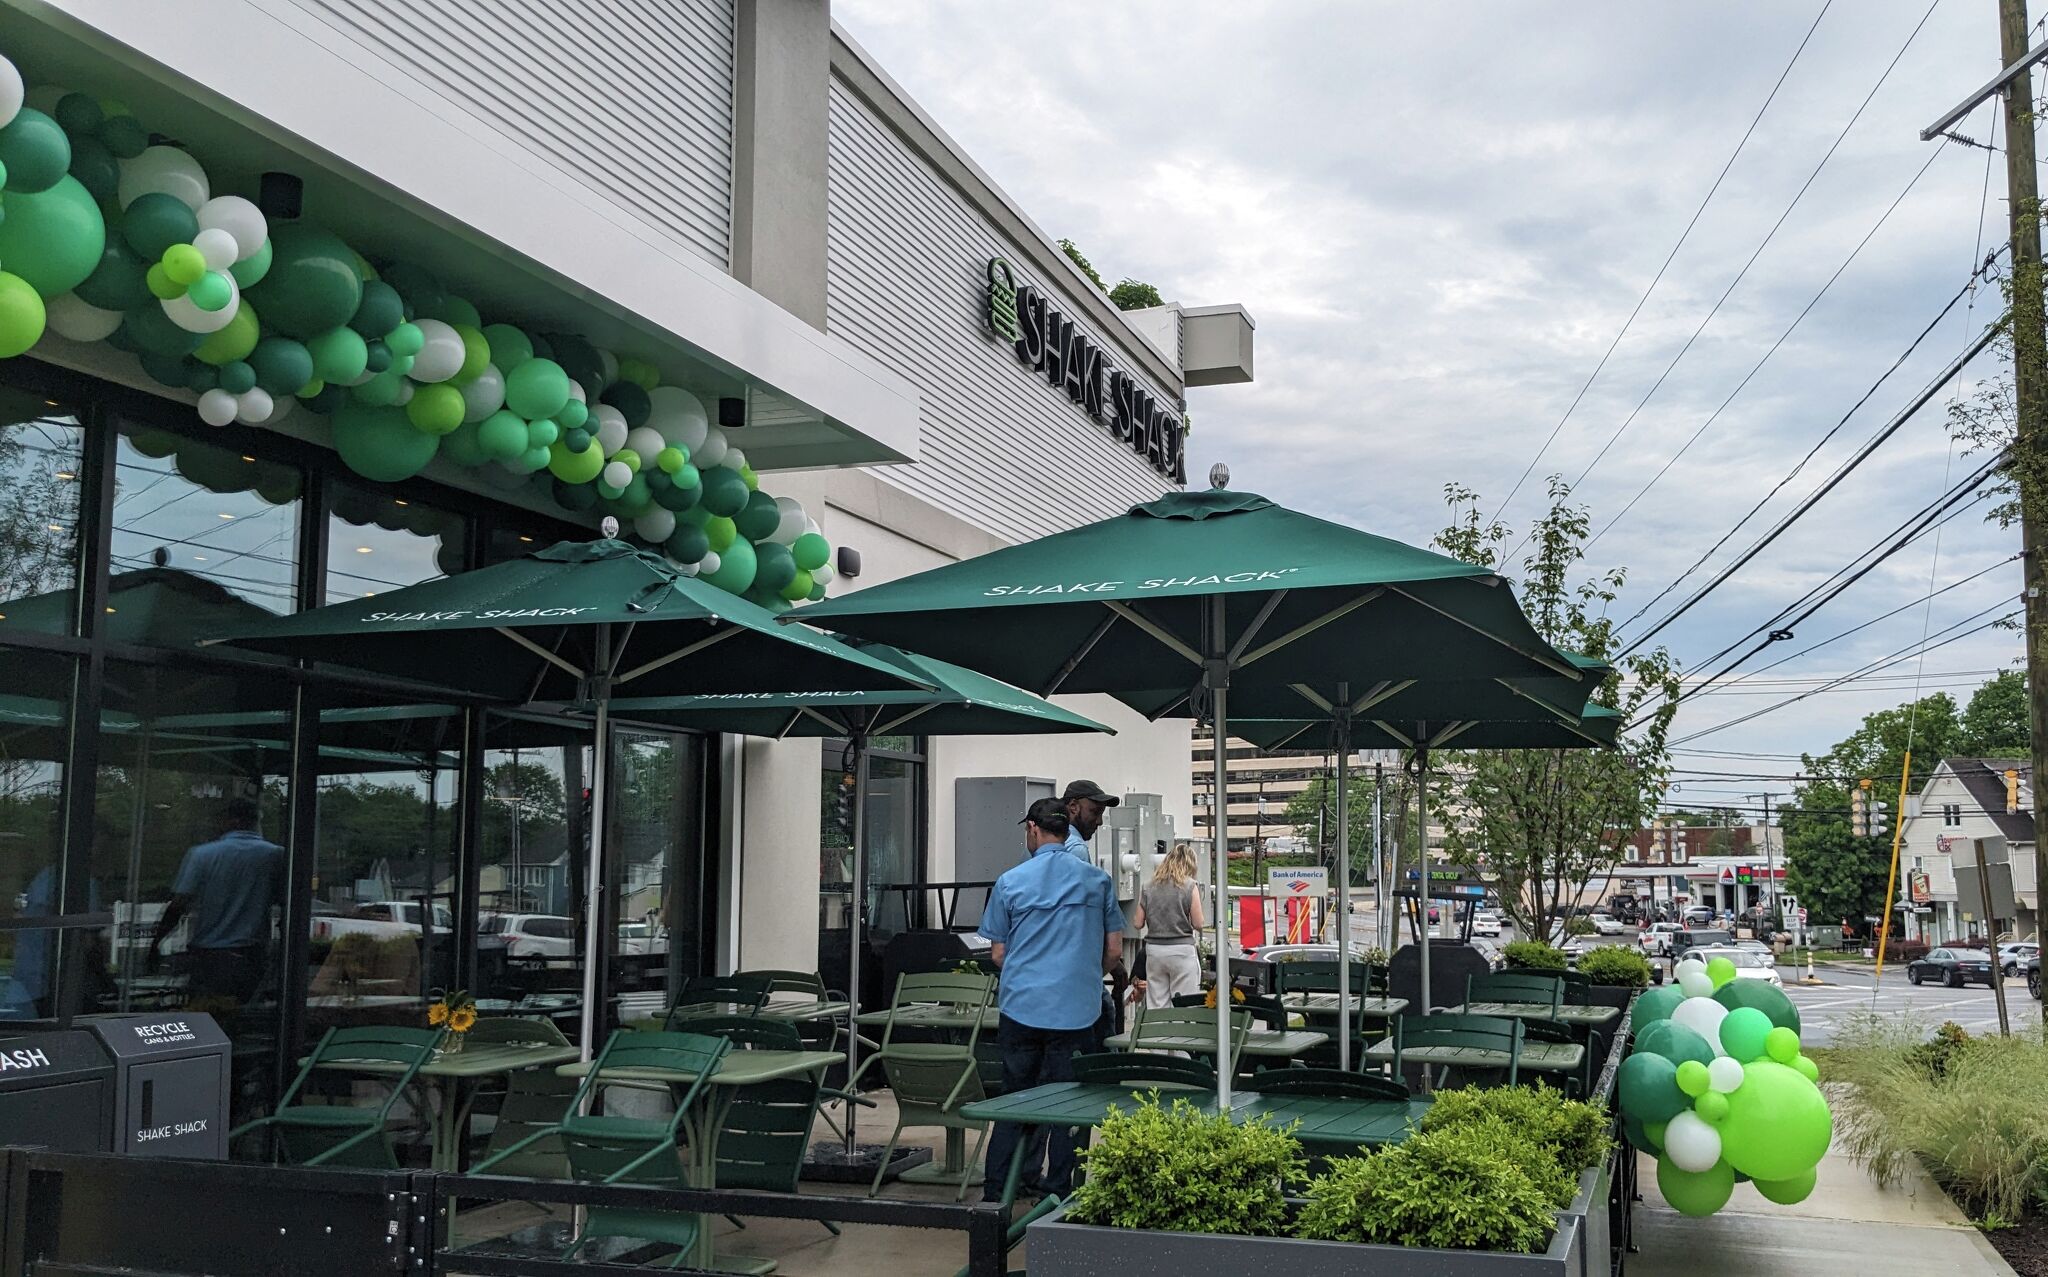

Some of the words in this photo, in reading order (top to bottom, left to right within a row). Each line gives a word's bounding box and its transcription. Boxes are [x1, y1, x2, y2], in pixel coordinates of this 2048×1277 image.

[1016, 285, 1112, 427] SHAKE
[1111, 371, 1187, 484] SHACK
[983, 581, 1124, 596] SHAKE
[1137, 568, 1288, 590] SHACK
[361, 611, 473, 623] SHAKE
[475, 607, 597, 619] SHACK
[134, 1021, 191, 1037] RECYCLE
[144, 1036, 164, 1045] CANS
[170, 1033, 196, 1042] BOTTLES
[0, 1048, 50, 1071] ASH
[137, 1126, 171, 1142] SHAKE
[174, 1119, 207, 1136] SHACK
